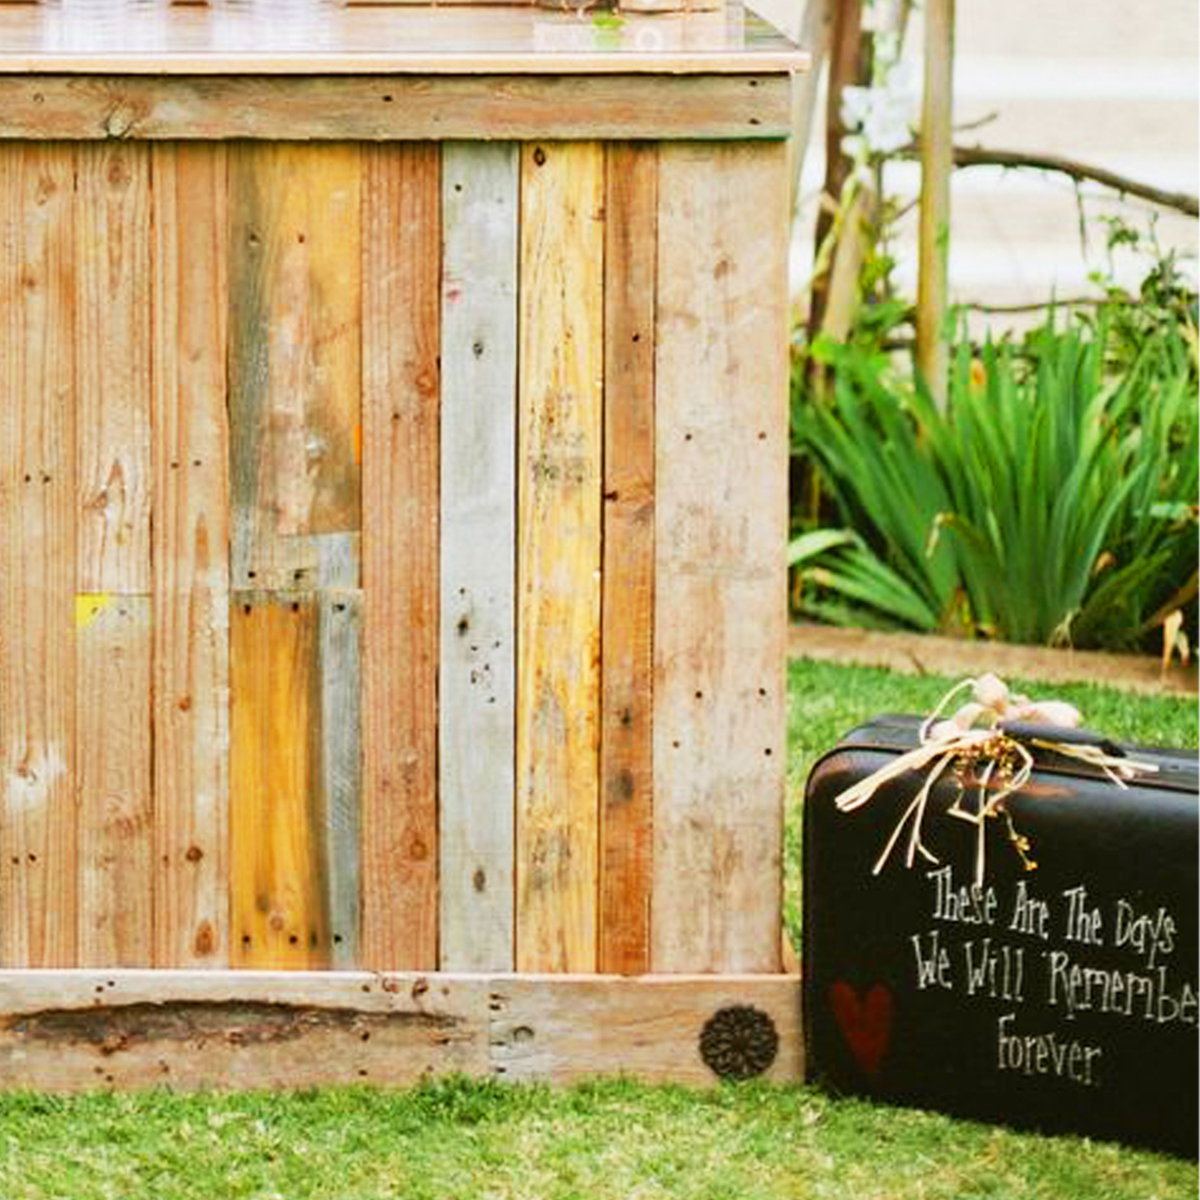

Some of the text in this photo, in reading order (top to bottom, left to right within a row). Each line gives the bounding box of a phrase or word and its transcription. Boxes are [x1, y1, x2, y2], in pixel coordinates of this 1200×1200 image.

[926, 865, 1178, 970] These Are The Days
[911, 930, 1199, 1024] We Will Remembe
[998, 1013, 1102, 1086] Forever
